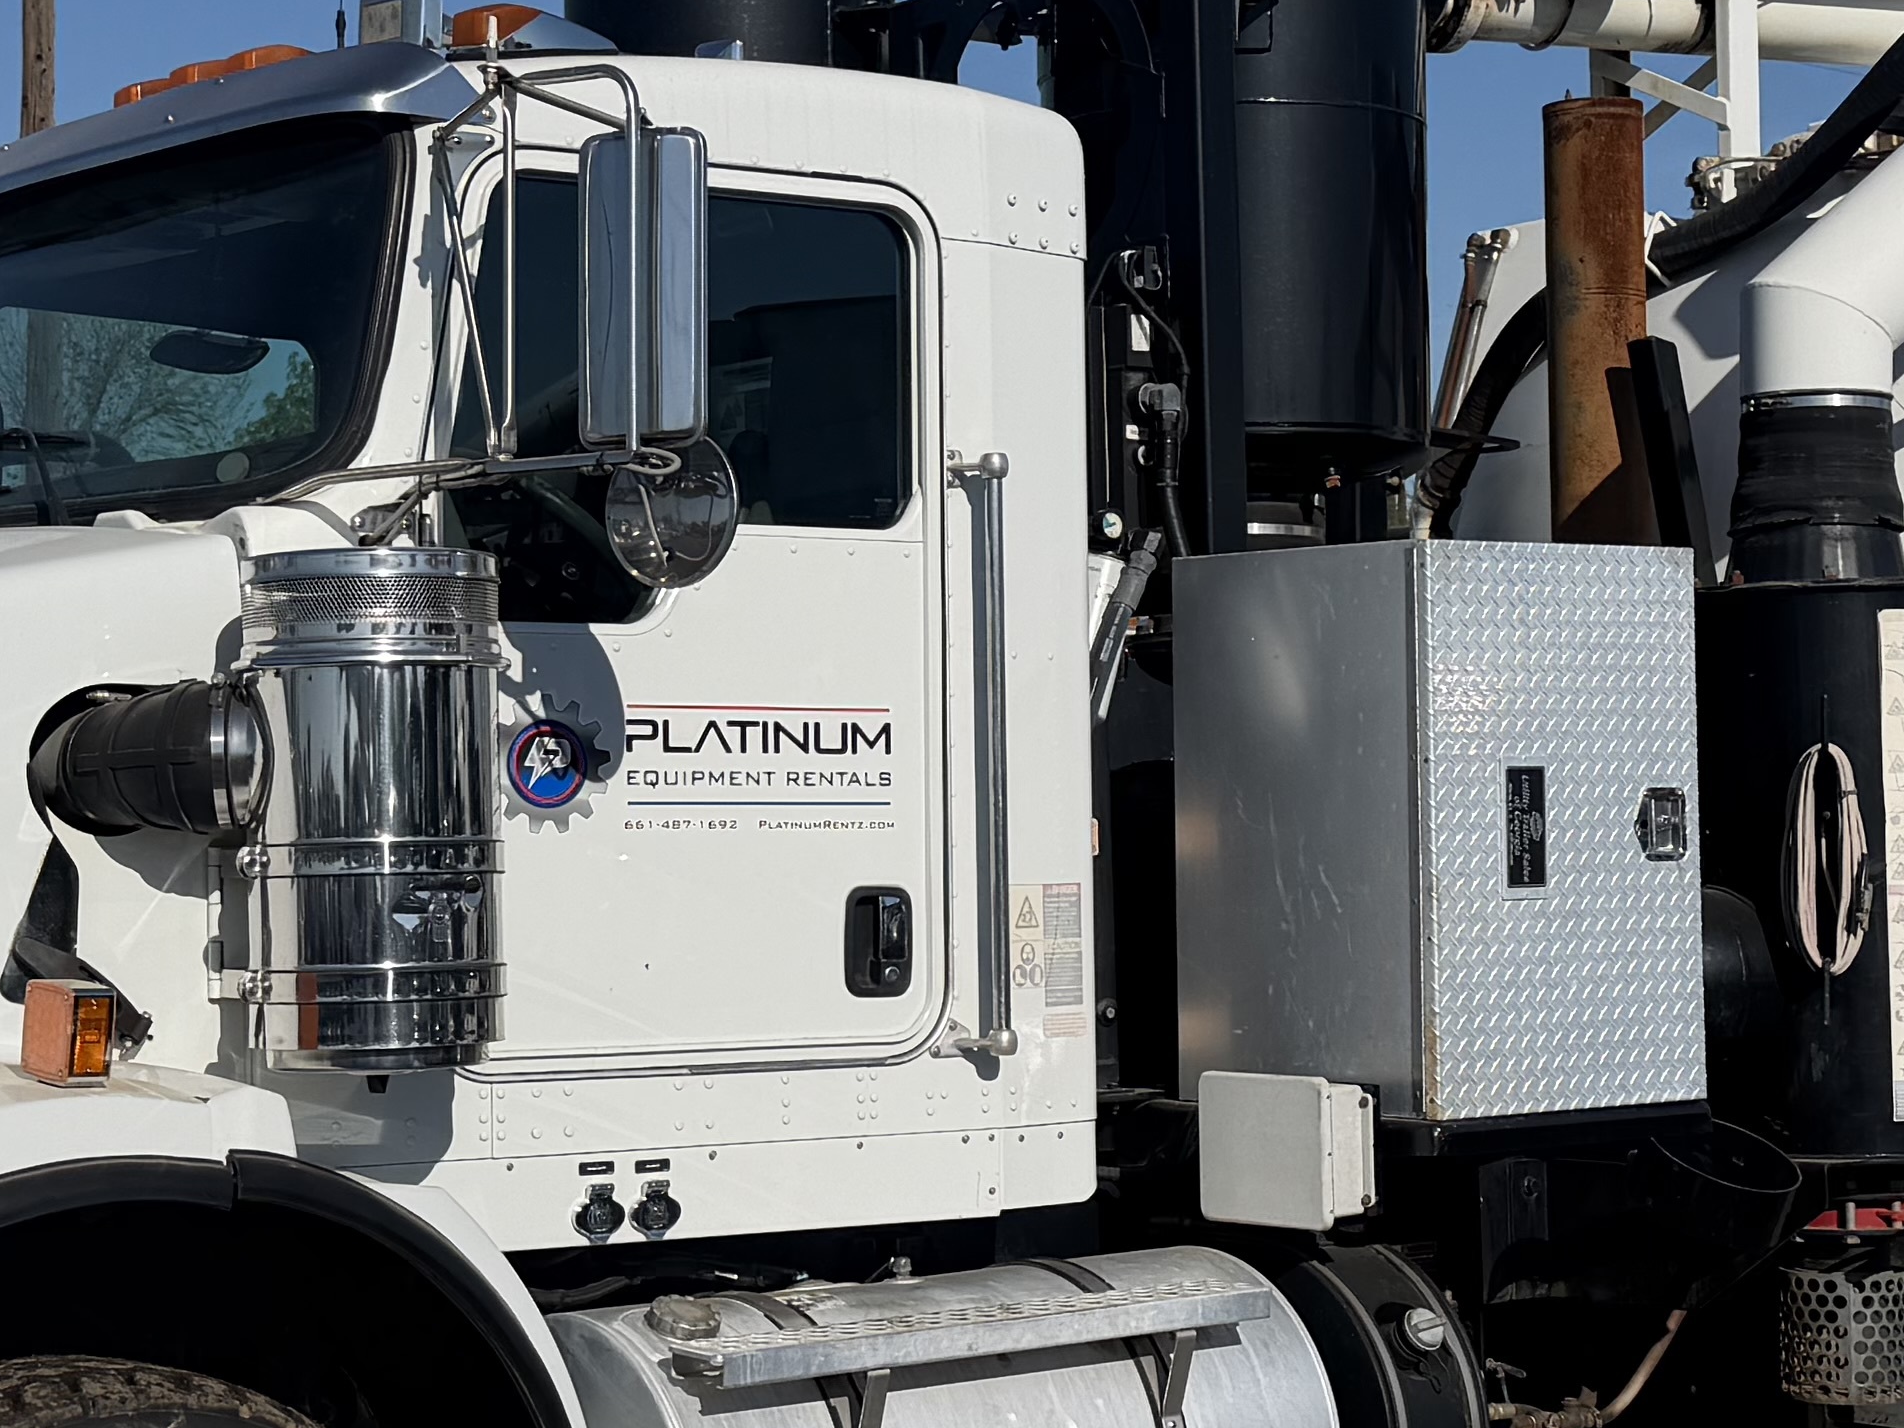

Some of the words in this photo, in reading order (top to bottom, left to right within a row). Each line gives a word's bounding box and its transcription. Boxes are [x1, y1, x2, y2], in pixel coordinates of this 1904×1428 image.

[625, 719, 892, 755] PLATINUM
[626, 770, 776, 789] EQUIPMENT
[785, 771, 893, 788] RENTALS
